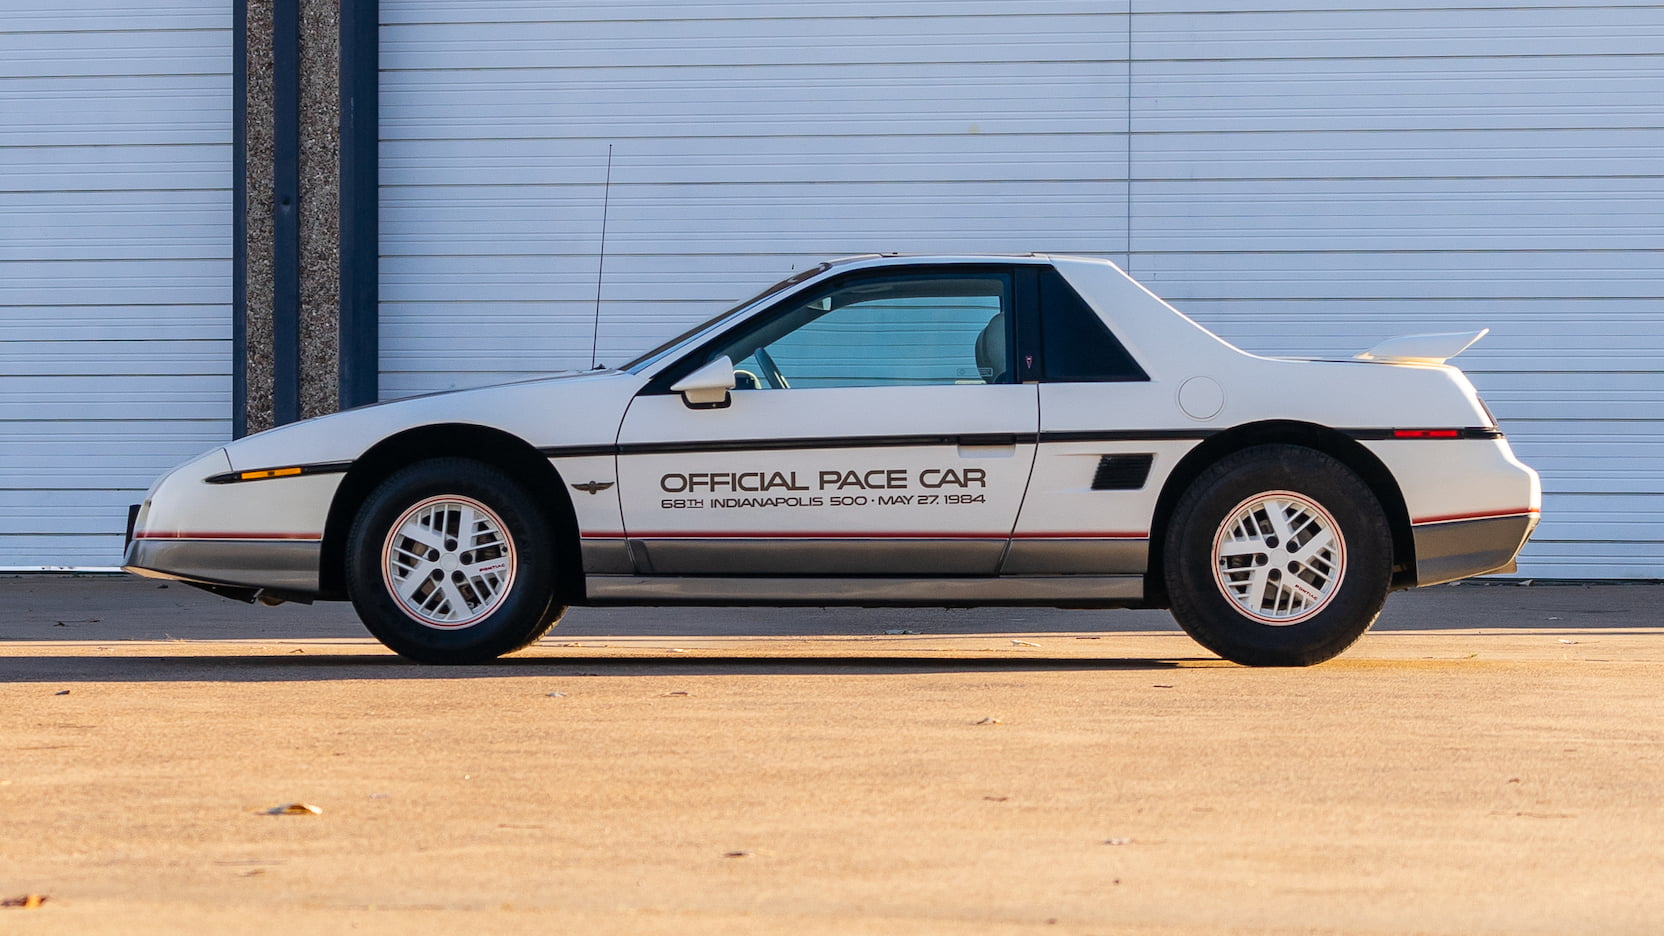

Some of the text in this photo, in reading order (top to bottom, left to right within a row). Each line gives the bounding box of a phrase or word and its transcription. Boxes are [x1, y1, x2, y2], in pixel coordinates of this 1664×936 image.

[660, 468, 986, 493] OFFICIAL PACE CAR
[661, 499, 704, 509] 68TH
[710, 497, 824, 508] INDIANAPOLIS
[830, 496, 868, 506] 500
[878, 495, 914, 506] MAY
[943, 494, 986, 505] 1984
